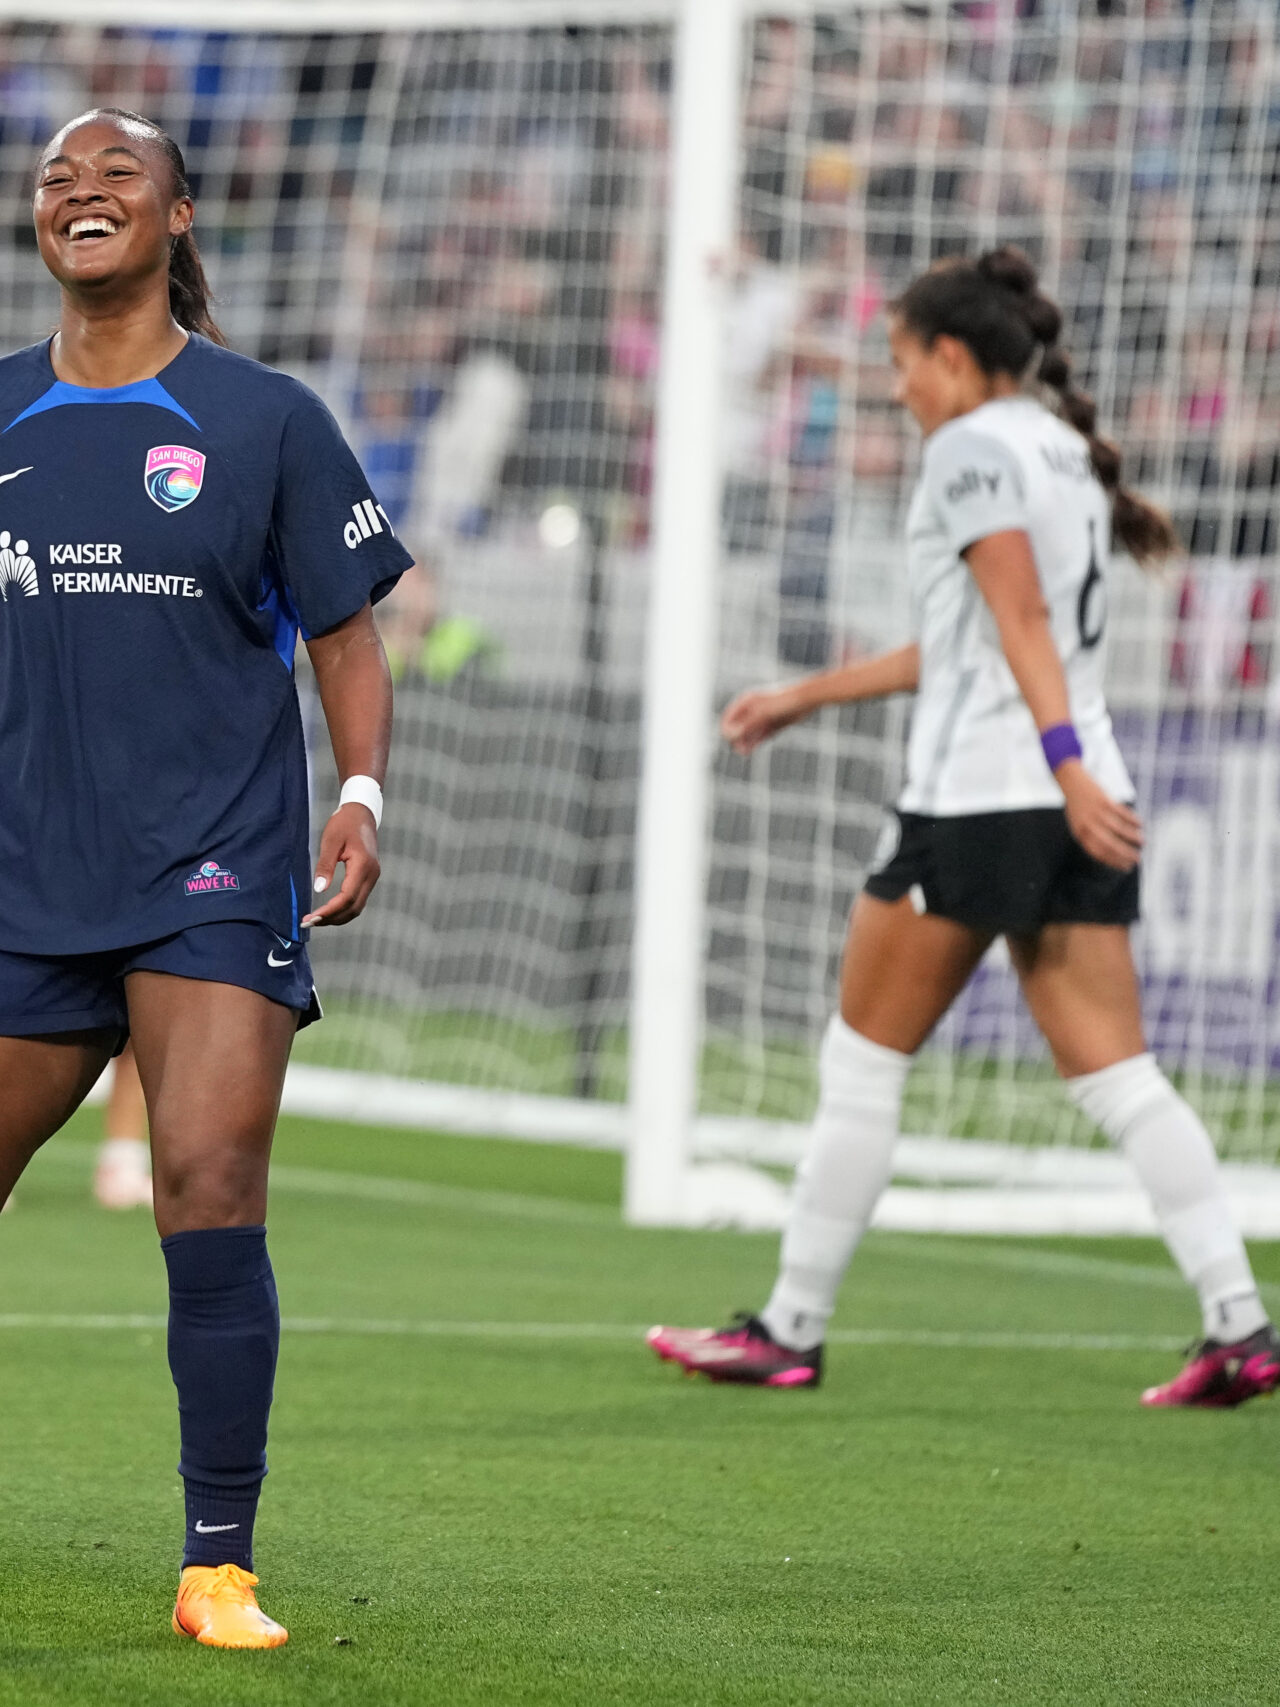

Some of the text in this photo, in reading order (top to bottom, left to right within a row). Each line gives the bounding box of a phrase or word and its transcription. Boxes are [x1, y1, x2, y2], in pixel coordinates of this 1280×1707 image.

[151, 450, 200, 468] SAN DIEGO
[49, 543, 123, 565] KAISER
[186, 876, 237, 892] WAVE FC
